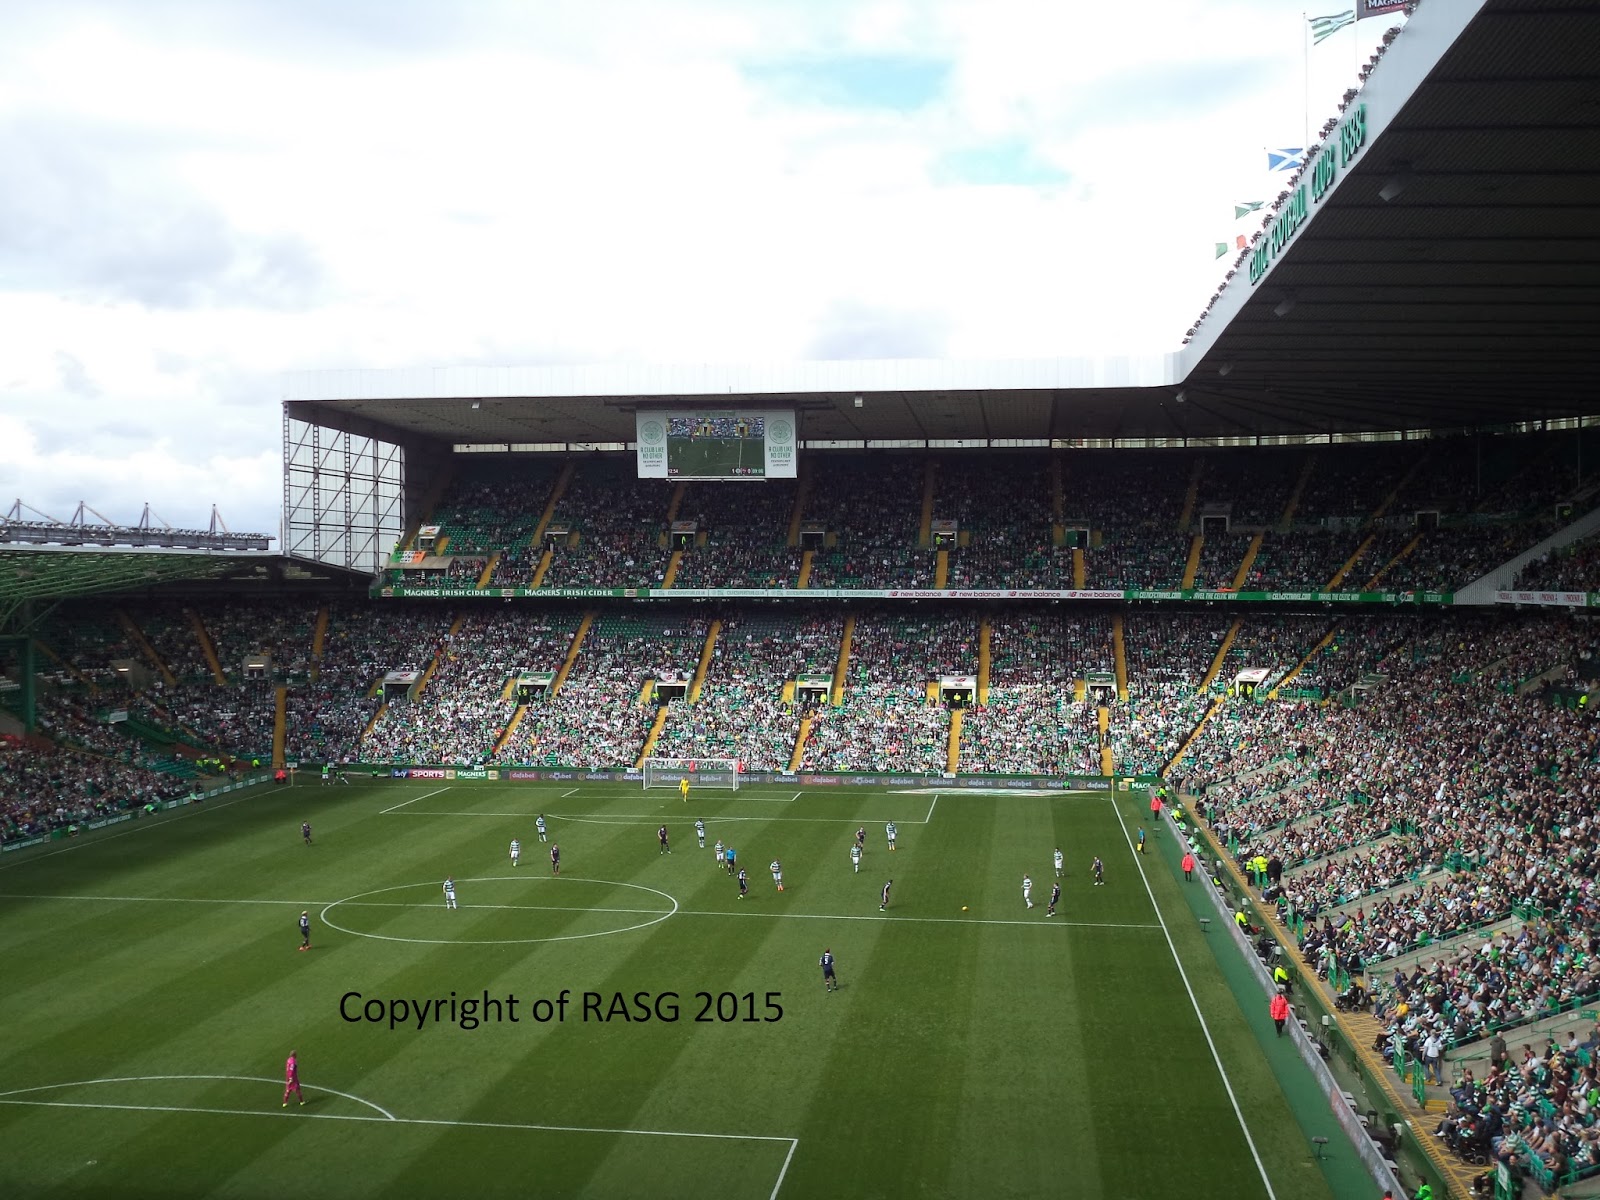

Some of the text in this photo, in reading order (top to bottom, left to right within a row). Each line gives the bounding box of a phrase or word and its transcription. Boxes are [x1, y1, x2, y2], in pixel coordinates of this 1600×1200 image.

[1339, 102, 1367, 168] 1888
[524, 588, 561, 596] MAGNERS
[412, 770, 445, 778] SPORTS
[812, 776, 837, 784] dafabet
[889, 777, 914, 785] dafabet
